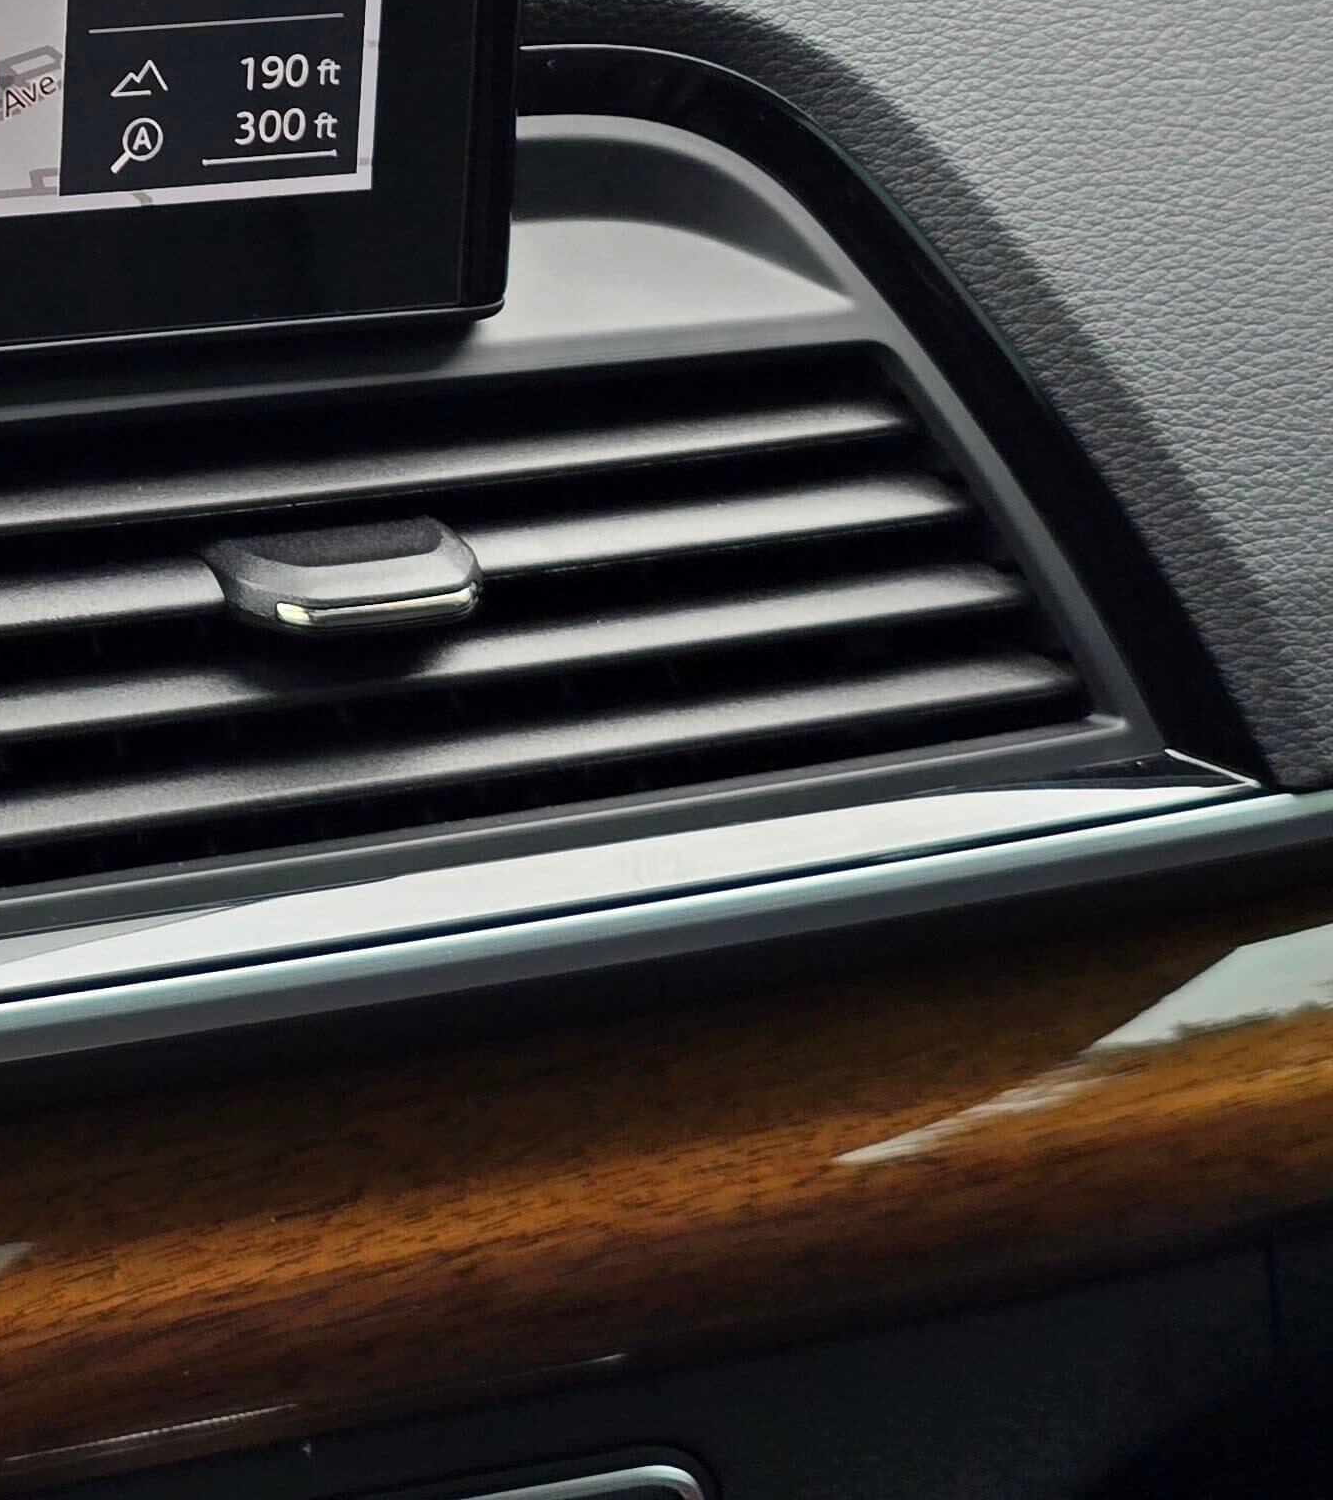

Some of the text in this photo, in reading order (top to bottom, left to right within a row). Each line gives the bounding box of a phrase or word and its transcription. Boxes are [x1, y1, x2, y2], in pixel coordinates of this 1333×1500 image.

[240, 52, 342, 92] 190 ft
[4, 75, 58, 118] Ave
[132, 125, 153, 151] A
[233, 107, 339, 146] 300 ft
